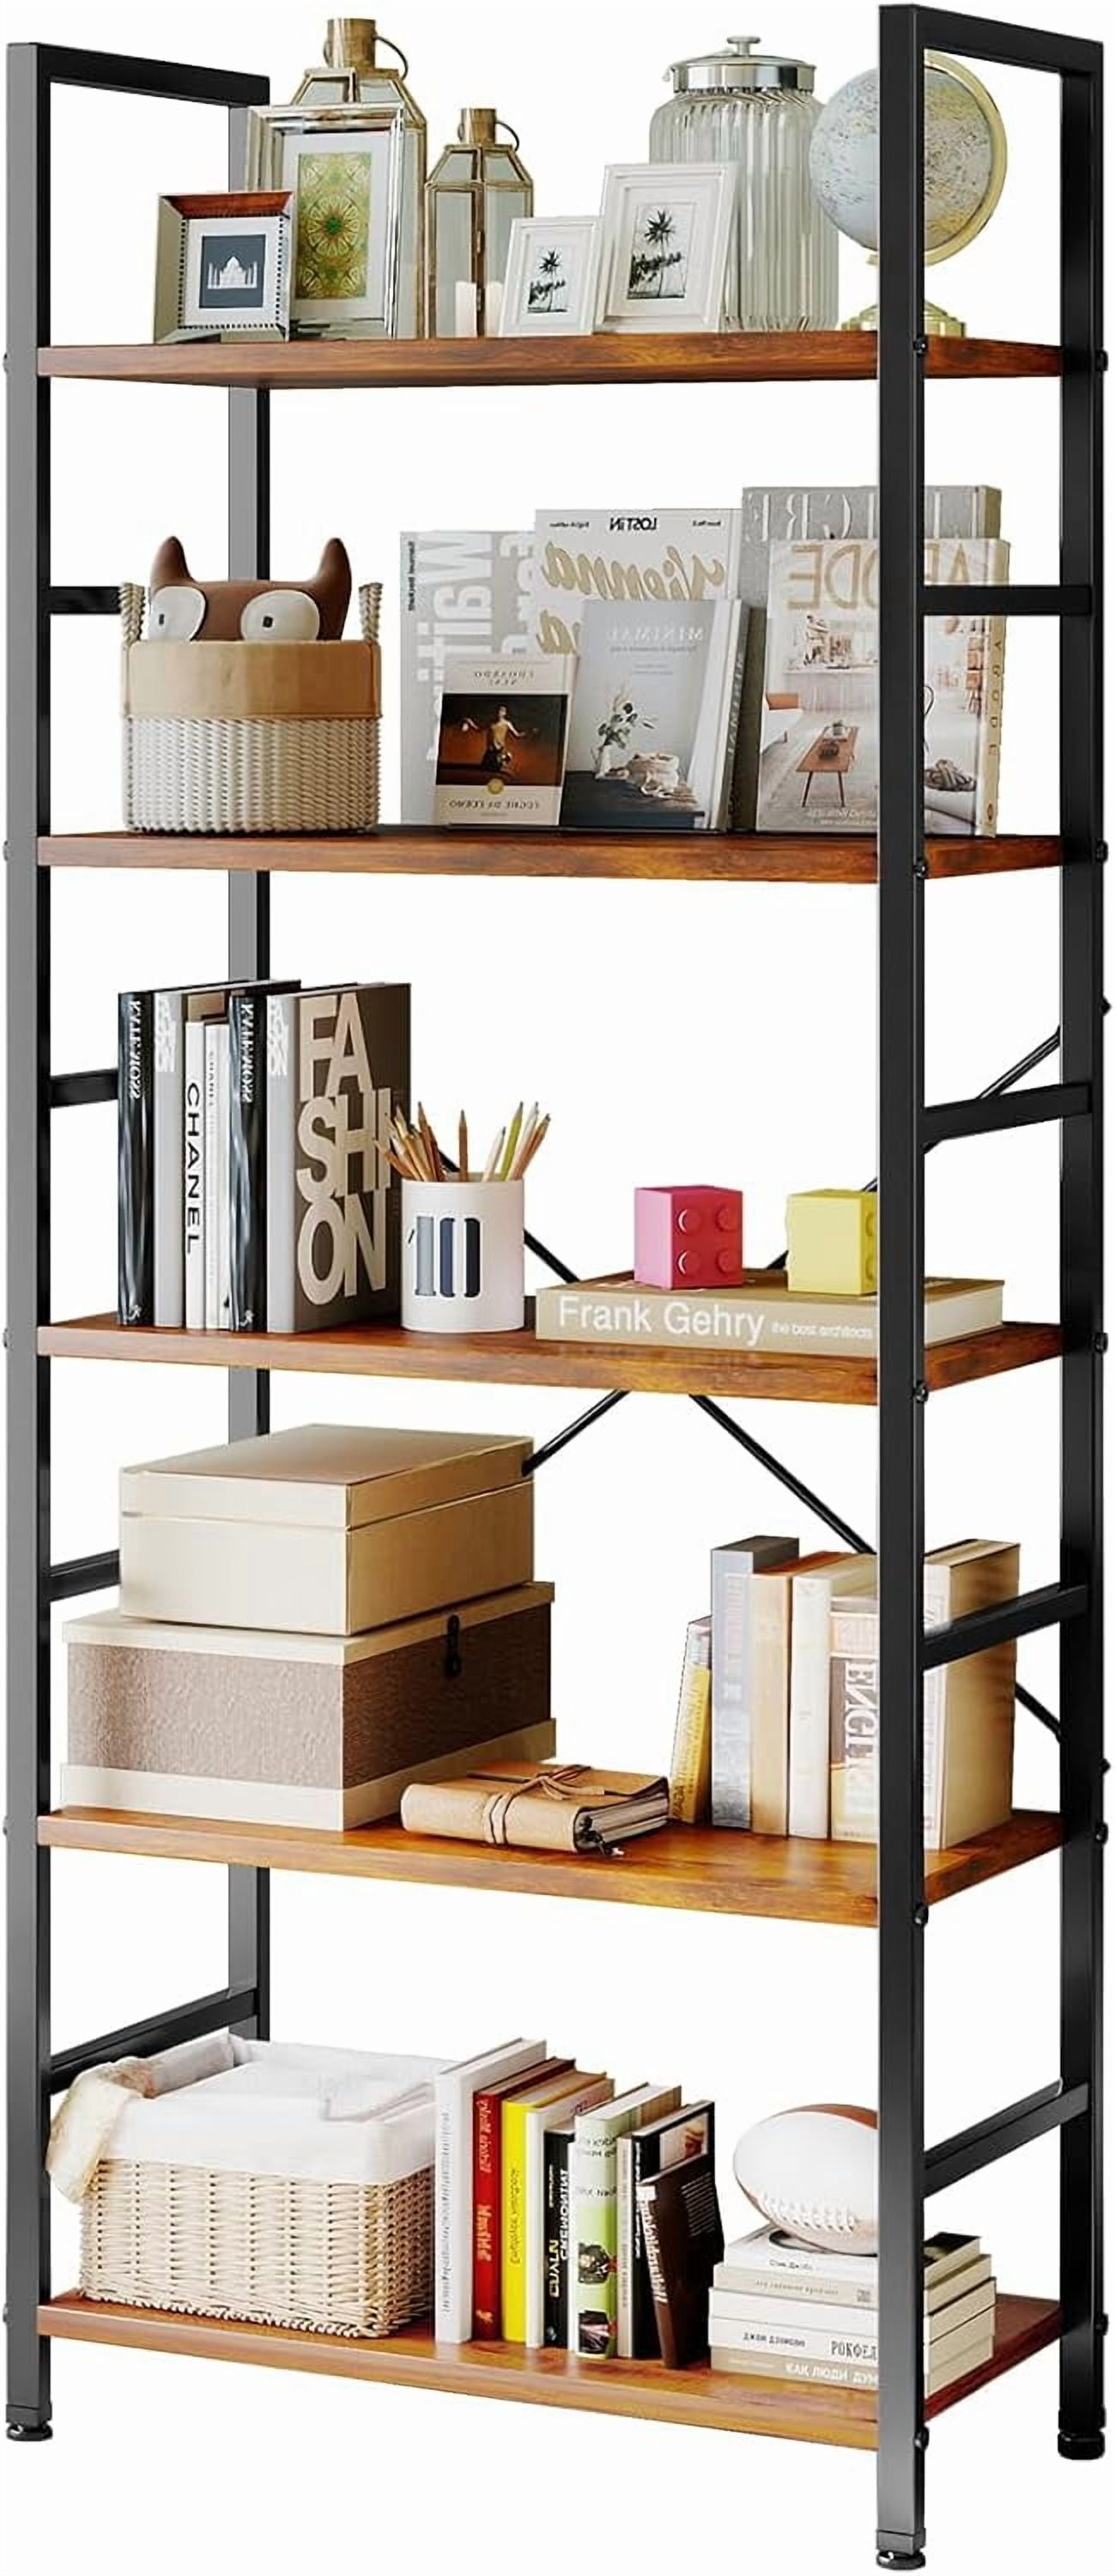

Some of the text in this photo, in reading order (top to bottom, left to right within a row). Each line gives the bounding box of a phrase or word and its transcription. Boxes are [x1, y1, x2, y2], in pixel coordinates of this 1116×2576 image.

[186, 1081, 201, 1255] CHANEL
[558, 1295, 652, 1334] Frank
[663, 1299, 765, 1347] Gehry
